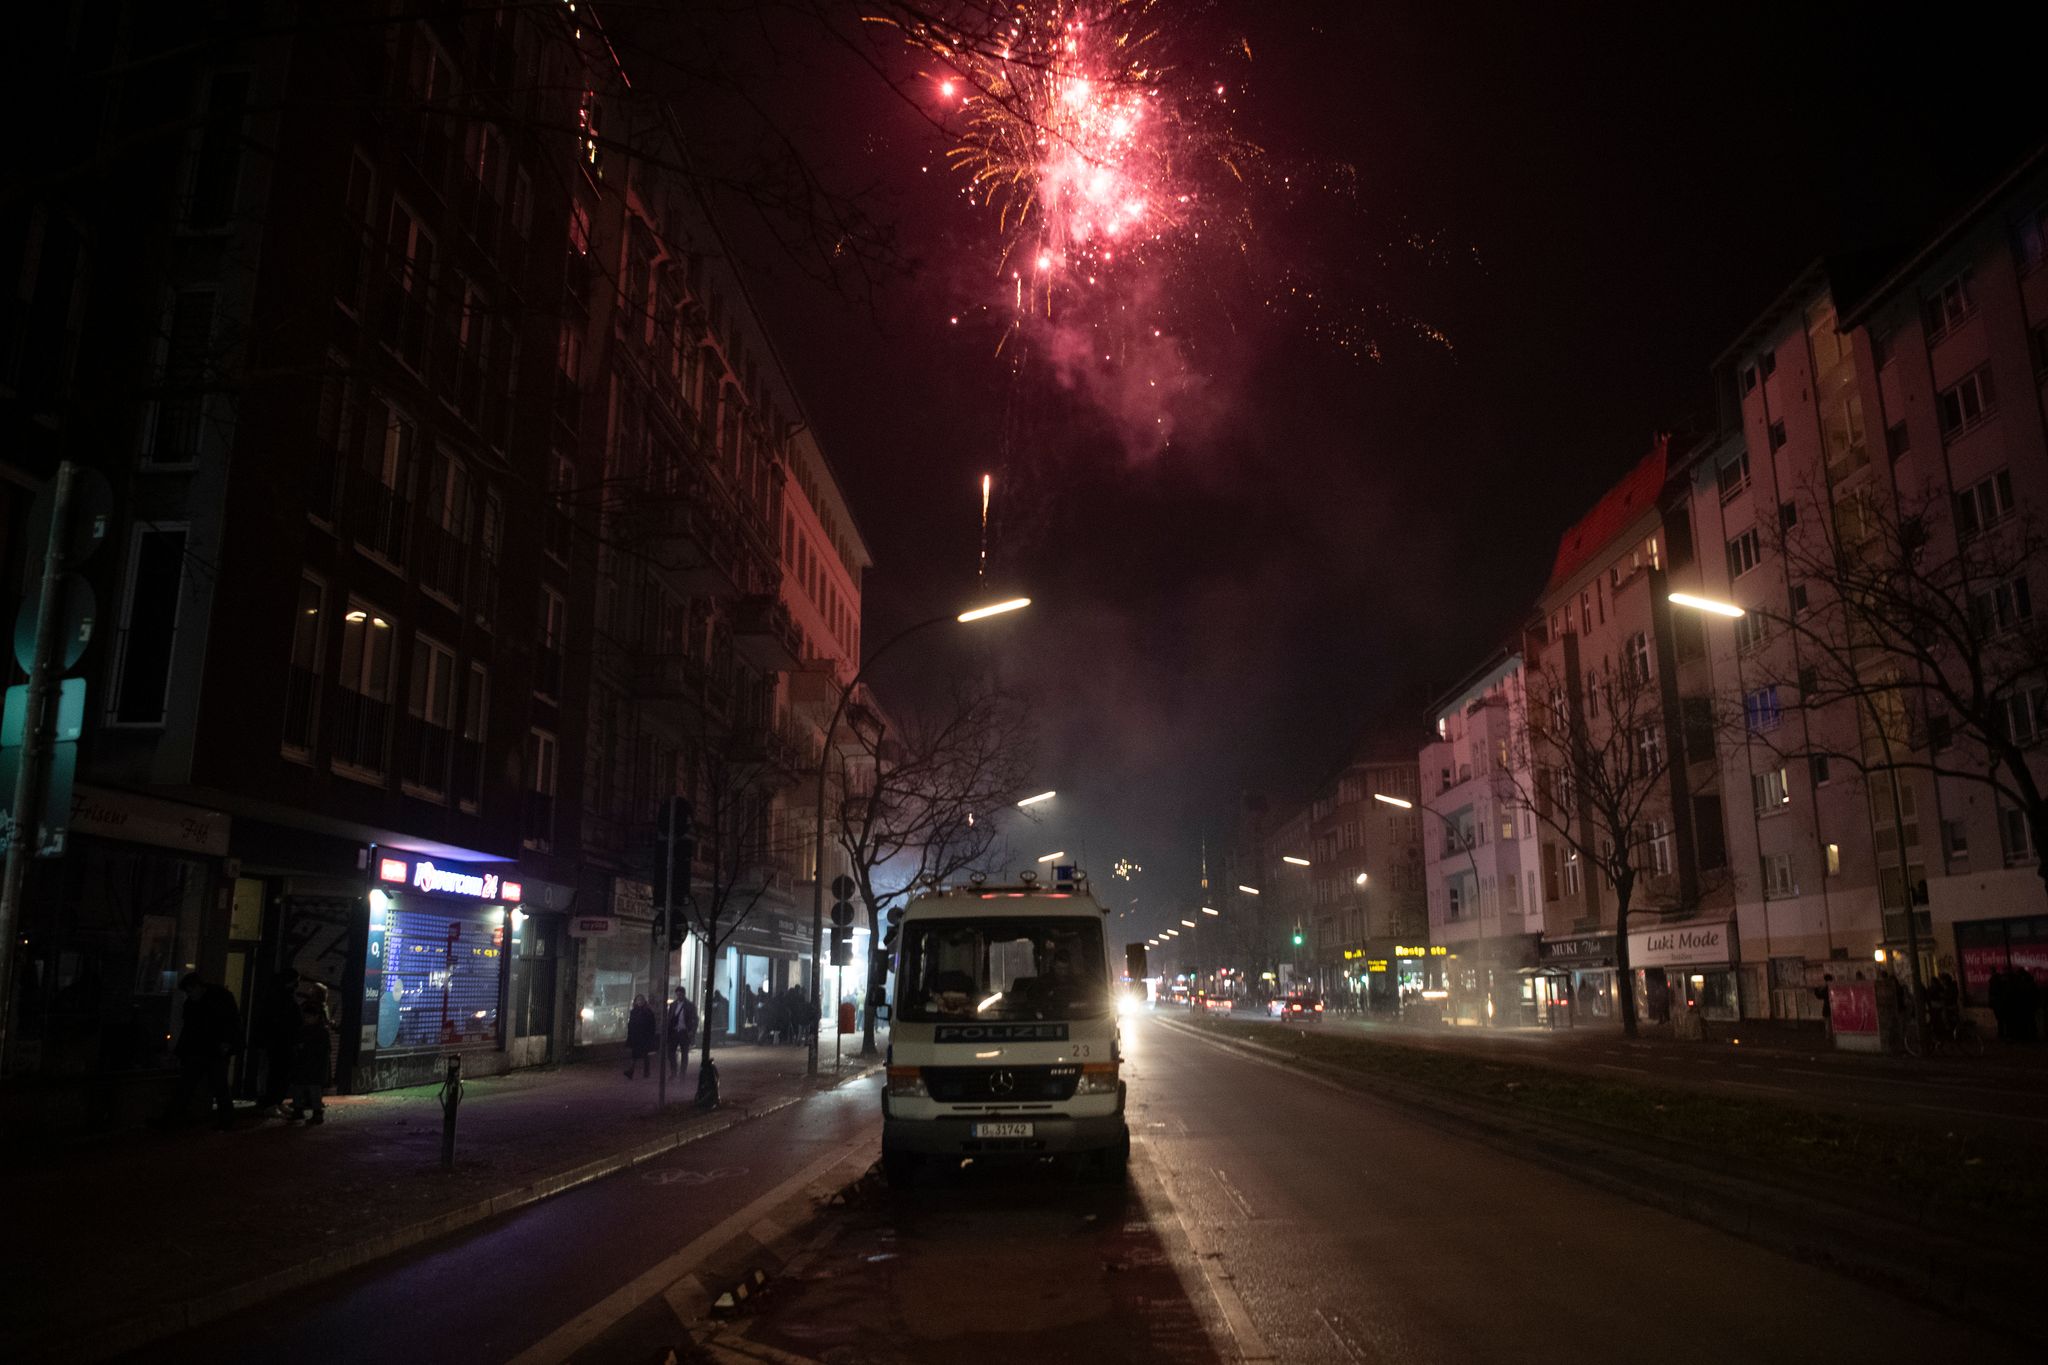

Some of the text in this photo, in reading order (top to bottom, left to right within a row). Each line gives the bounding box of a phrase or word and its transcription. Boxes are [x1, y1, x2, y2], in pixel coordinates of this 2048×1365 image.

[1647, 931, 1719, 951] Luki Mode
[1552, 942, 1578, 957] MUKI
[940, 1026, 1063, 1039] POLIZEI
[1072, 1045, 1090, 1057] 23
